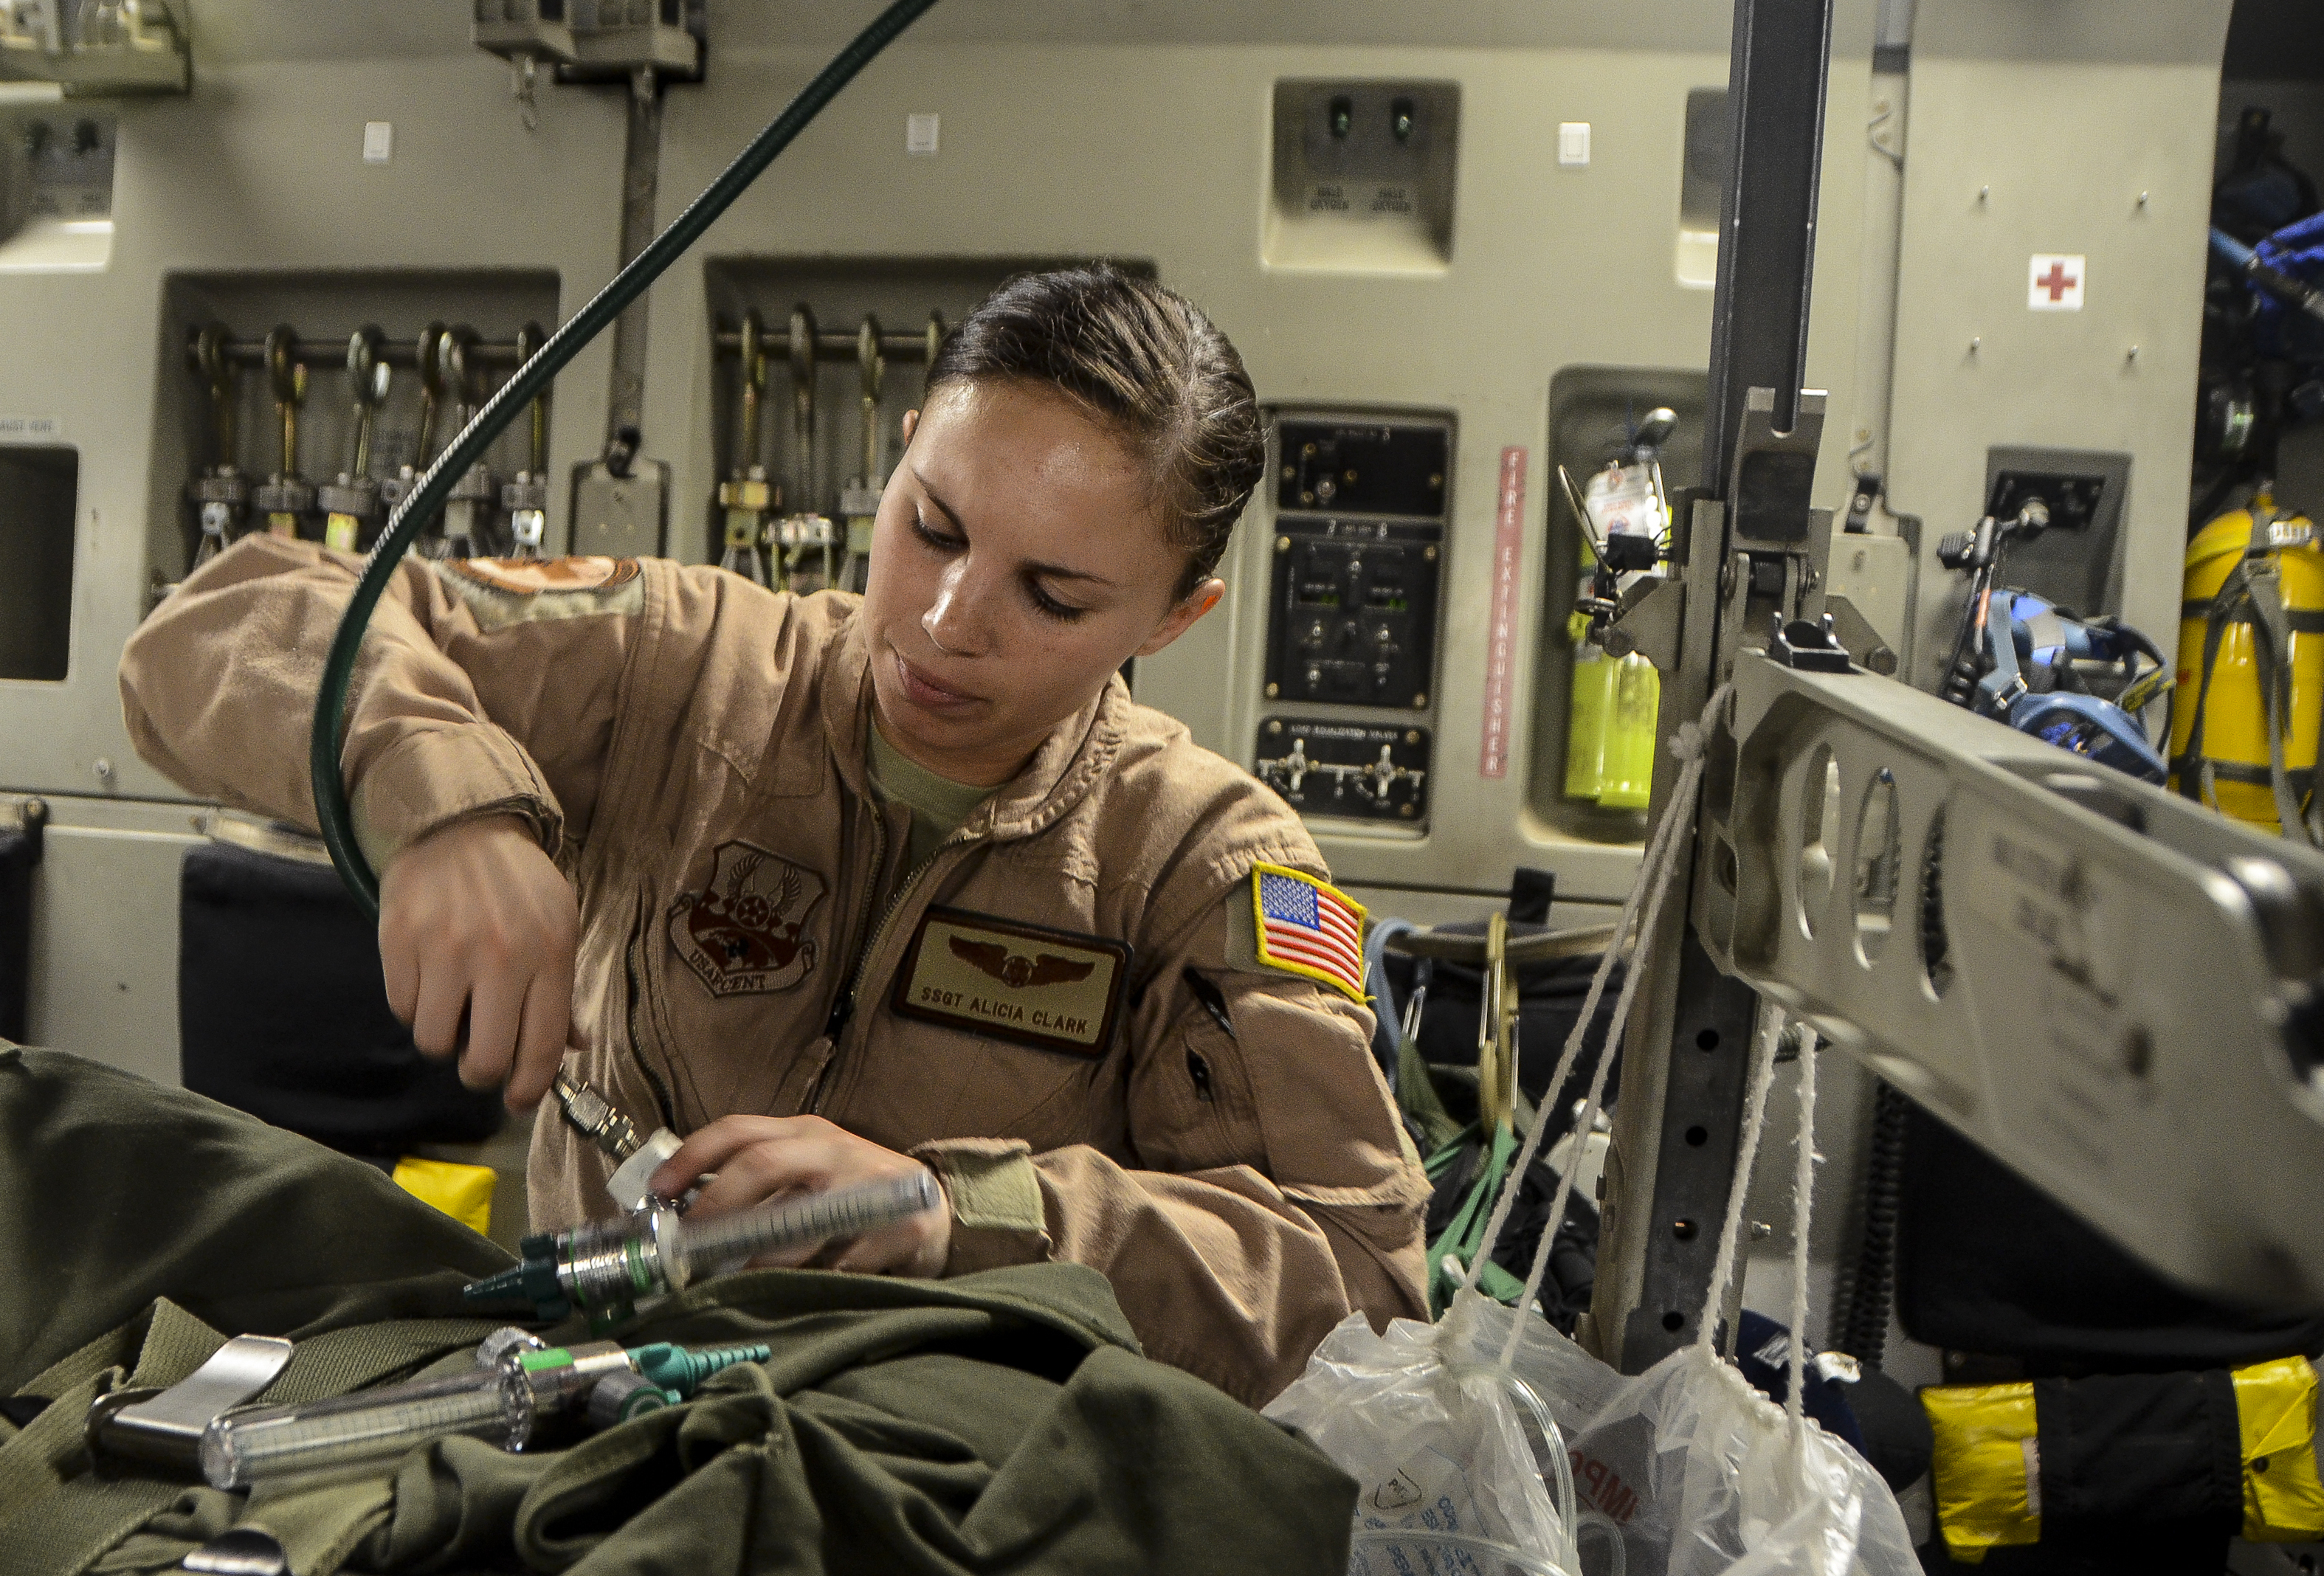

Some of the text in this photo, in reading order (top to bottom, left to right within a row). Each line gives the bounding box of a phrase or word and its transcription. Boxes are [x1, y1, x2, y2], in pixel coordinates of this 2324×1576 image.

[1486, 451, 1519, 772] FIRE EXTINGUISHER
[921, 986, 1088, 1034] SSGT ALICIA CLARK
